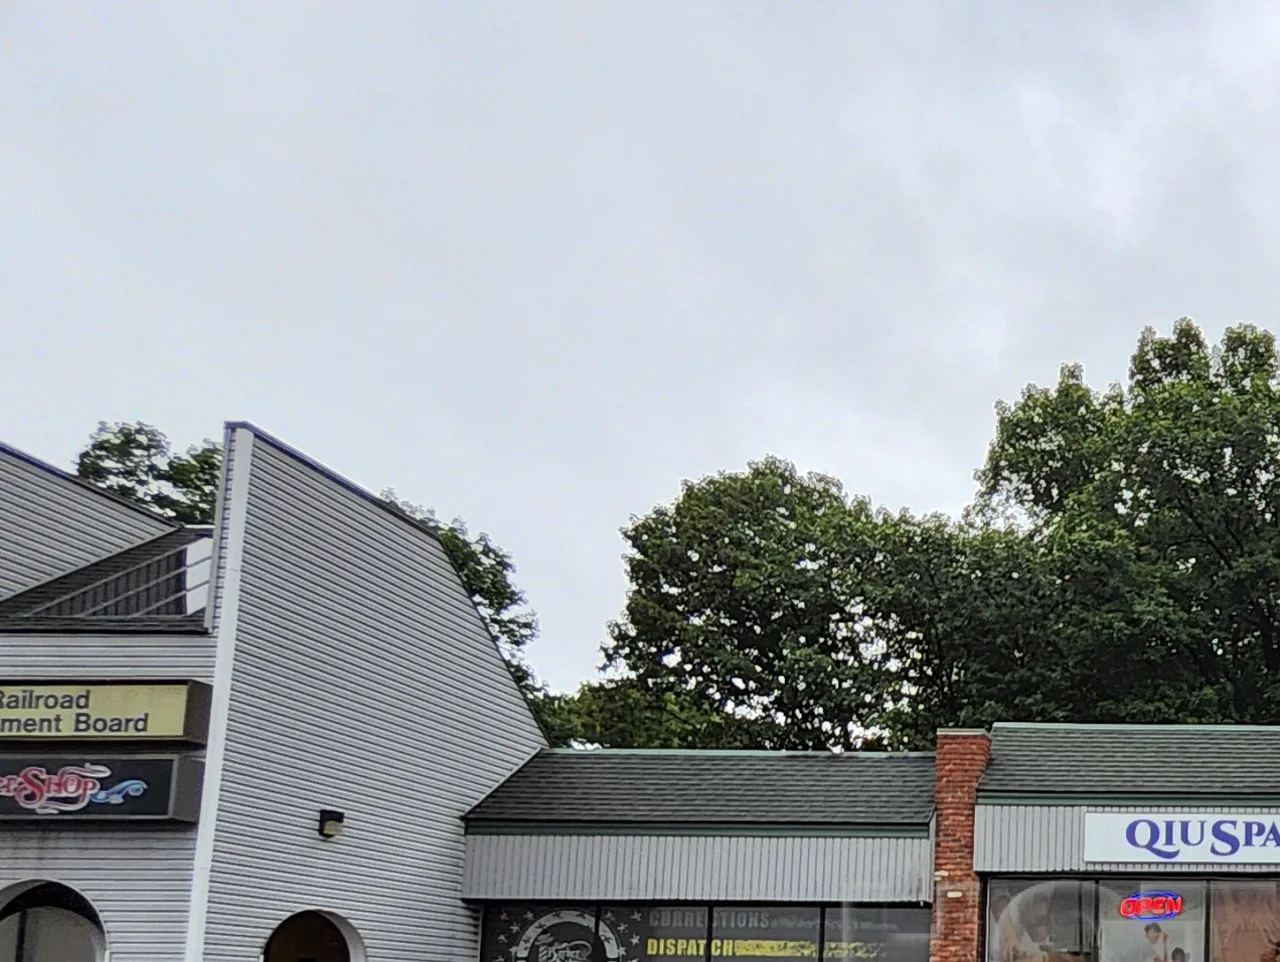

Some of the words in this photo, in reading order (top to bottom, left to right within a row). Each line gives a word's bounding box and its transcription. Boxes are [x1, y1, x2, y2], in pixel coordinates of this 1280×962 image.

[74, 713, 148, 732] Board
[1119, 896, 1183, 917] OPEN
[647, 938, 733, 957] DISPATCH
